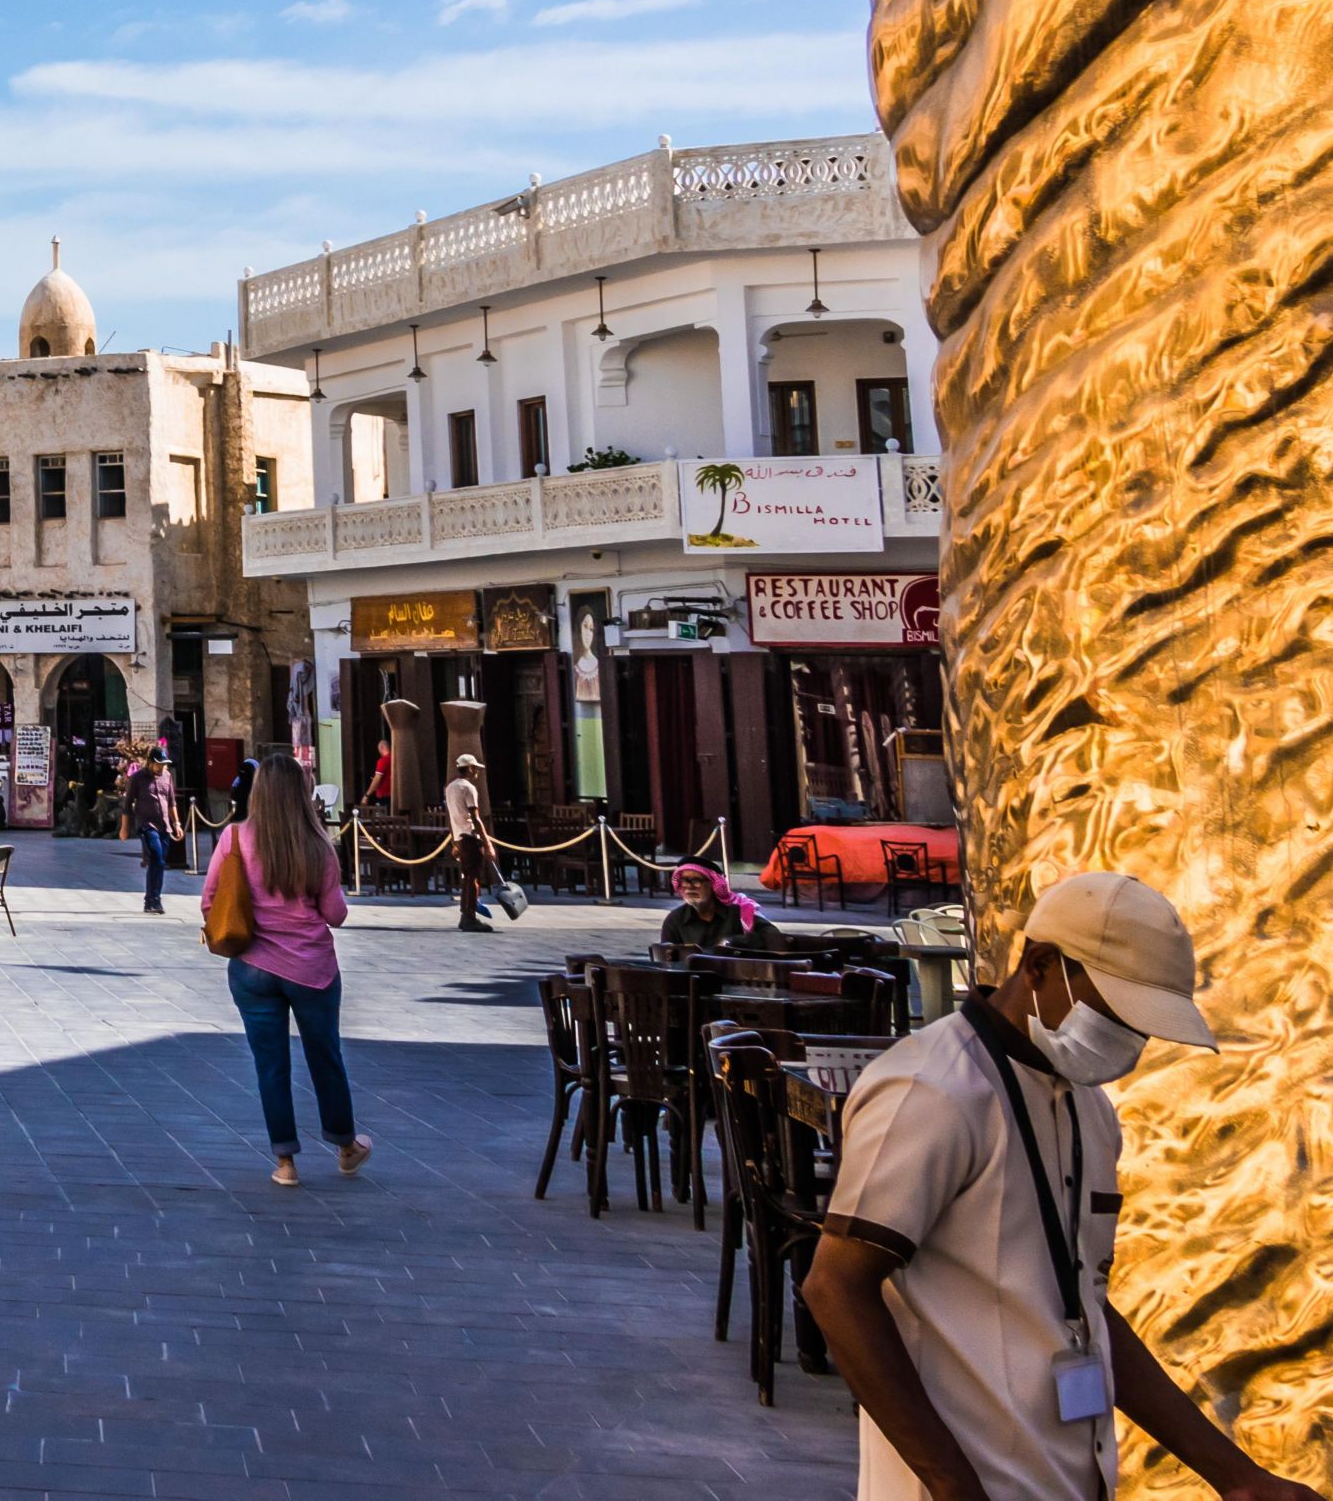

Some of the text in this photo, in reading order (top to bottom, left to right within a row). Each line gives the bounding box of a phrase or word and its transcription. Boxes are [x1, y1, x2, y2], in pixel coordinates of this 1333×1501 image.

[744, 464, 773, 480] الله
[732, 491, 824, 514] BISMILLA
[813, 517, 873, 526] HOTEL
[754, 578, 899, 598] RESTAURANT
[0, 603, 73, 623] الخليفي
[76, 602, 130, 621] متجر
[758, 600, 899, 620] & COFFEE SHOP
[13, 625, 22, 633] &
[25, 624, 82, 633] KHELAIFI
[906, 630, 940, 642] BISMIL
